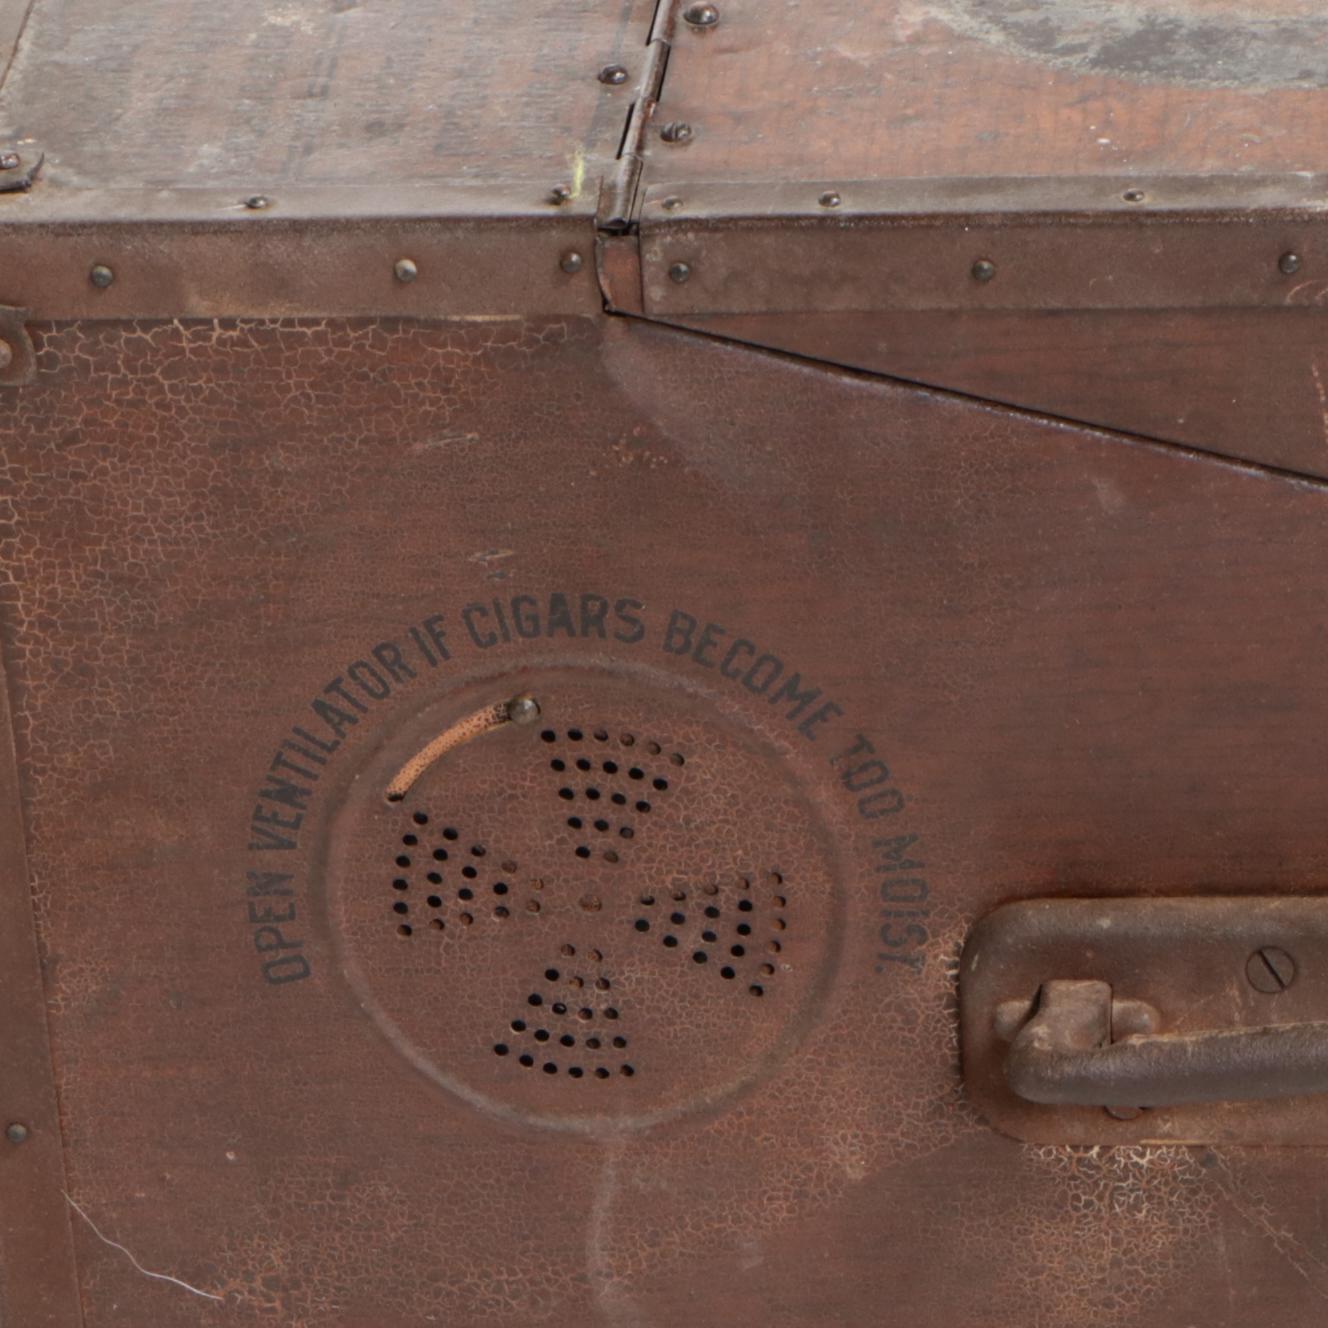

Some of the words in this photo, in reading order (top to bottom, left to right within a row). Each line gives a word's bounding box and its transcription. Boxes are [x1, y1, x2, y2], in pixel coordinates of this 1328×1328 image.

[411, 615, 456, 667] IF
[462, 593, 646, 648] CIGARS
[664, 610, 844, 740] BECOME
[248, 642, 417, 854] VENTILATOR
[840, 732, 905, 820] TOO
[248, 870, 311, 986] OPEN
